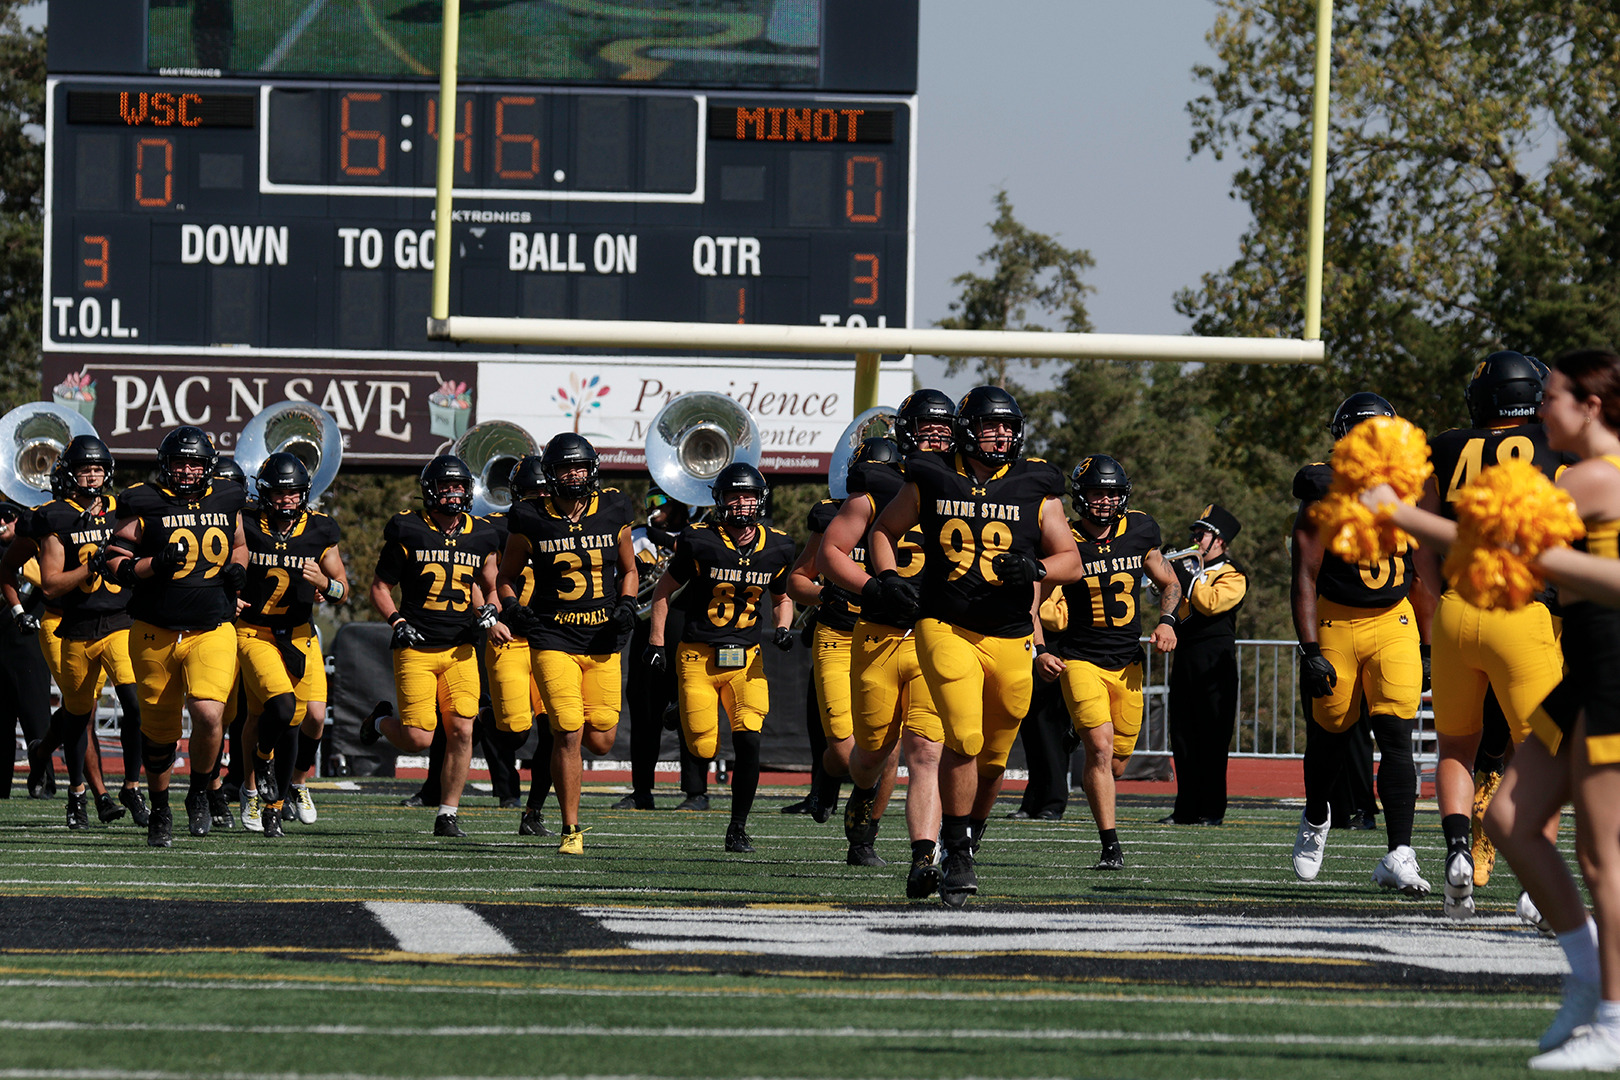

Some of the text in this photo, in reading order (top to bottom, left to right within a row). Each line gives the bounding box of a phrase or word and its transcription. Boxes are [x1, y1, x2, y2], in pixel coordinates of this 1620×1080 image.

[119, 91, 202, 127] WSC
[735, 106, 865, 142] MINOT
[135, 137, 173, 207] 0
[846, 155, 882, 223] 0
[430, 209, 532, 223] KTRONICS
[83, 236, 109, 289] 3
[180, 224, 289, 266] DOWN
[338, 228, 384, 267] TO
[508, 232, 638, 273] BALL ON
[692, 236, 762, 276] QTR
[853, 253, 879, 305] 3
[52, 297, 139, 338] T.O.L.
[110, 374, 213, 437] PAC
[225, 377, 270, 422] N
[162, 513, 197, 528] WAYNE
[936, 499, 1020, 521] WAYNE STATE
[70, 529, 103, 545] WAYNE
[168, 526, 229, 580] 99
[415, 549, 450, 562] WAYNE
[538, 533, 614, 553] WAYNE STATE
[939, 517, 1013, 586] 98
[260, 567, 290, 615] 2
[419, 562, 474, 612] 25
[552, 548, 605, 601] 31
[709, 566, 742, 582] WAYNE
[553, 607, 609, 626] FOOTBALL
[707, 582, 764, 629] 82
[1083, 571, 1136, 628] 13
